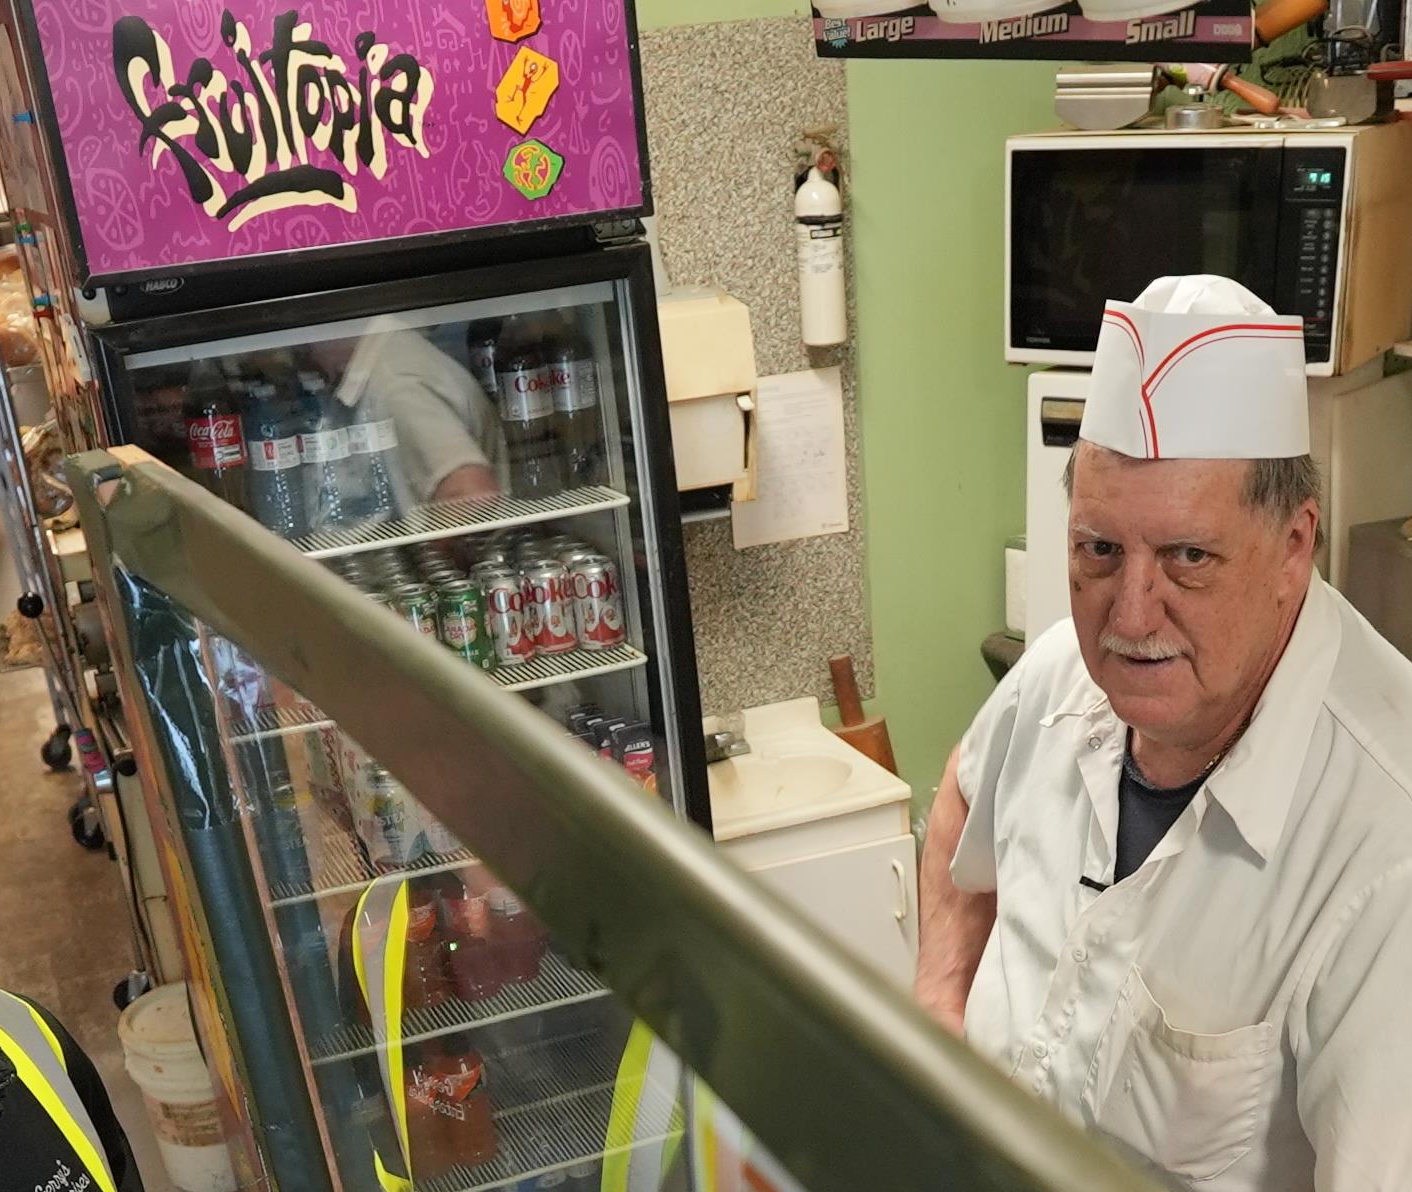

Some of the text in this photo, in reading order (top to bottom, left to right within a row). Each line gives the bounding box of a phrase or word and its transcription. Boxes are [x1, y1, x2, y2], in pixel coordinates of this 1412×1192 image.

[855, 16, 914, 42] Large
[979, 12, 1069, 44] Medium
[1125, 11, 1195, 45] Small
[571, 572, 617, 600] Cok
